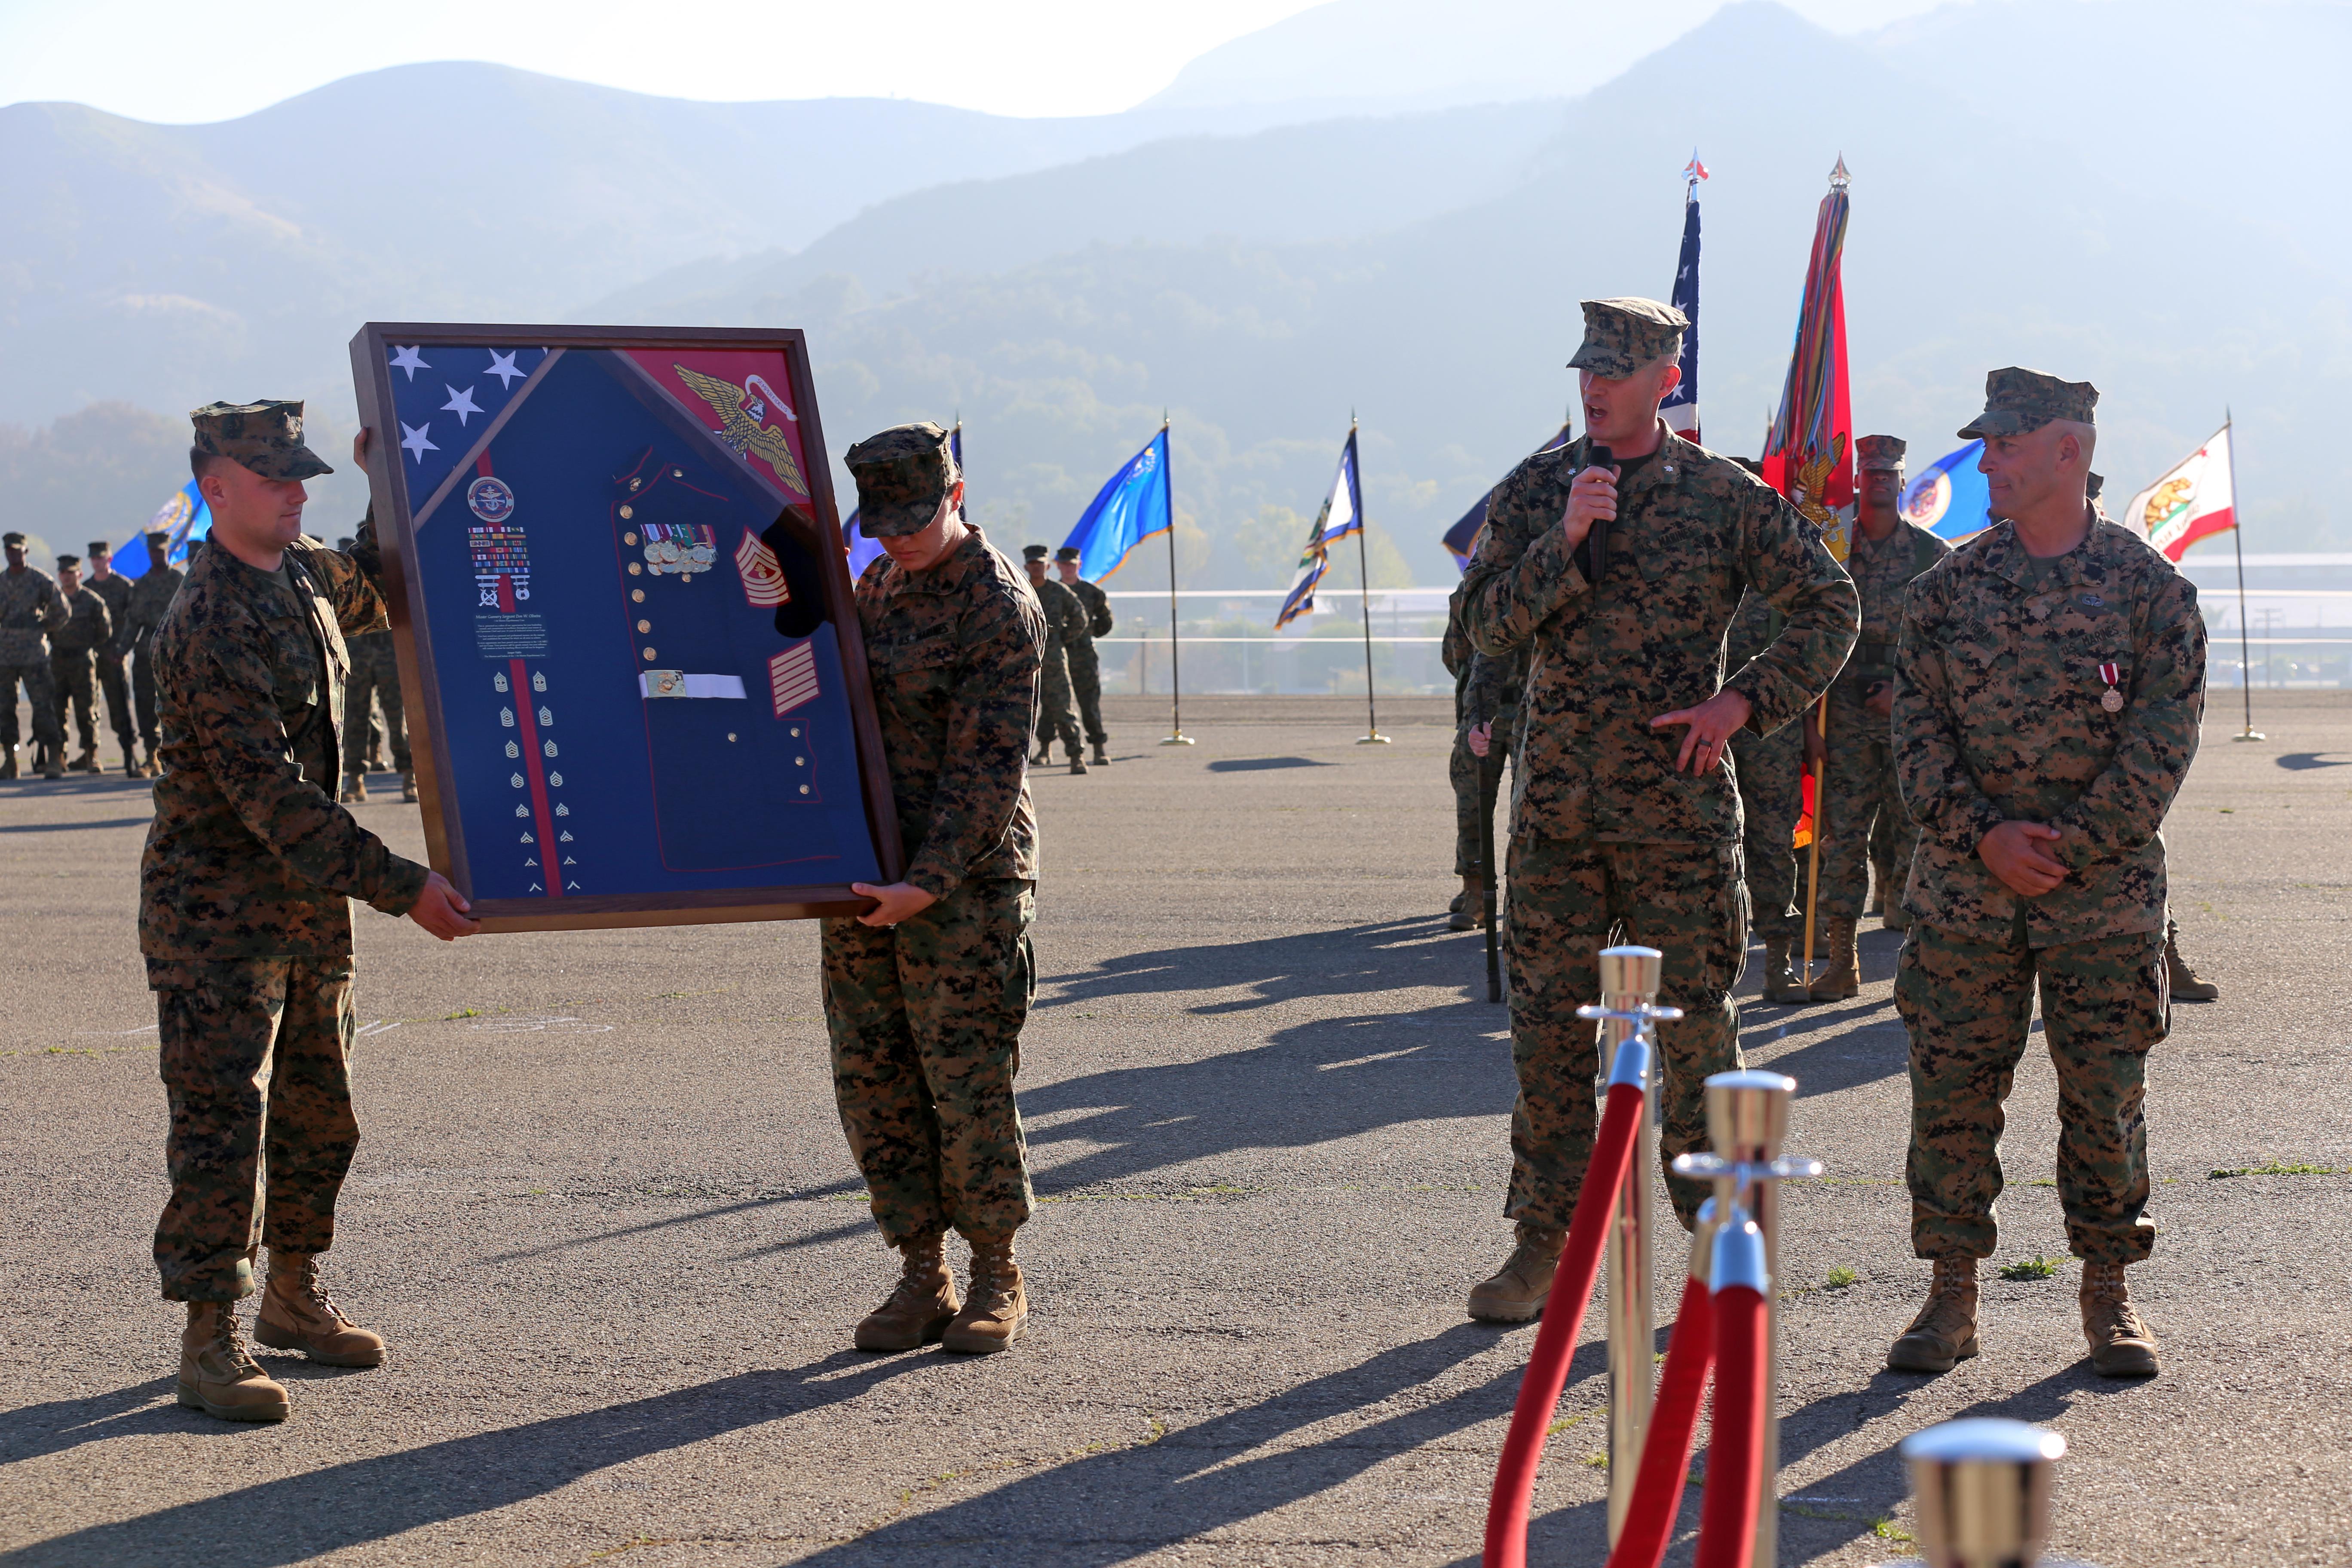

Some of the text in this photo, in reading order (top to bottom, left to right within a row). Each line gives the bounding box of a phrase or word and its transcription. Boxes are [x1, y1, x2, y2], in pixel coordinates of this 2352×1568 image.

[756, 378, 788, 413] SEMPER FIDELIS
[1657, 527, 1695, 548] MARINES
[1961, 612, 1993, 642] OLIVEIRA
[2082, 625, 2119, 647] MARINES
